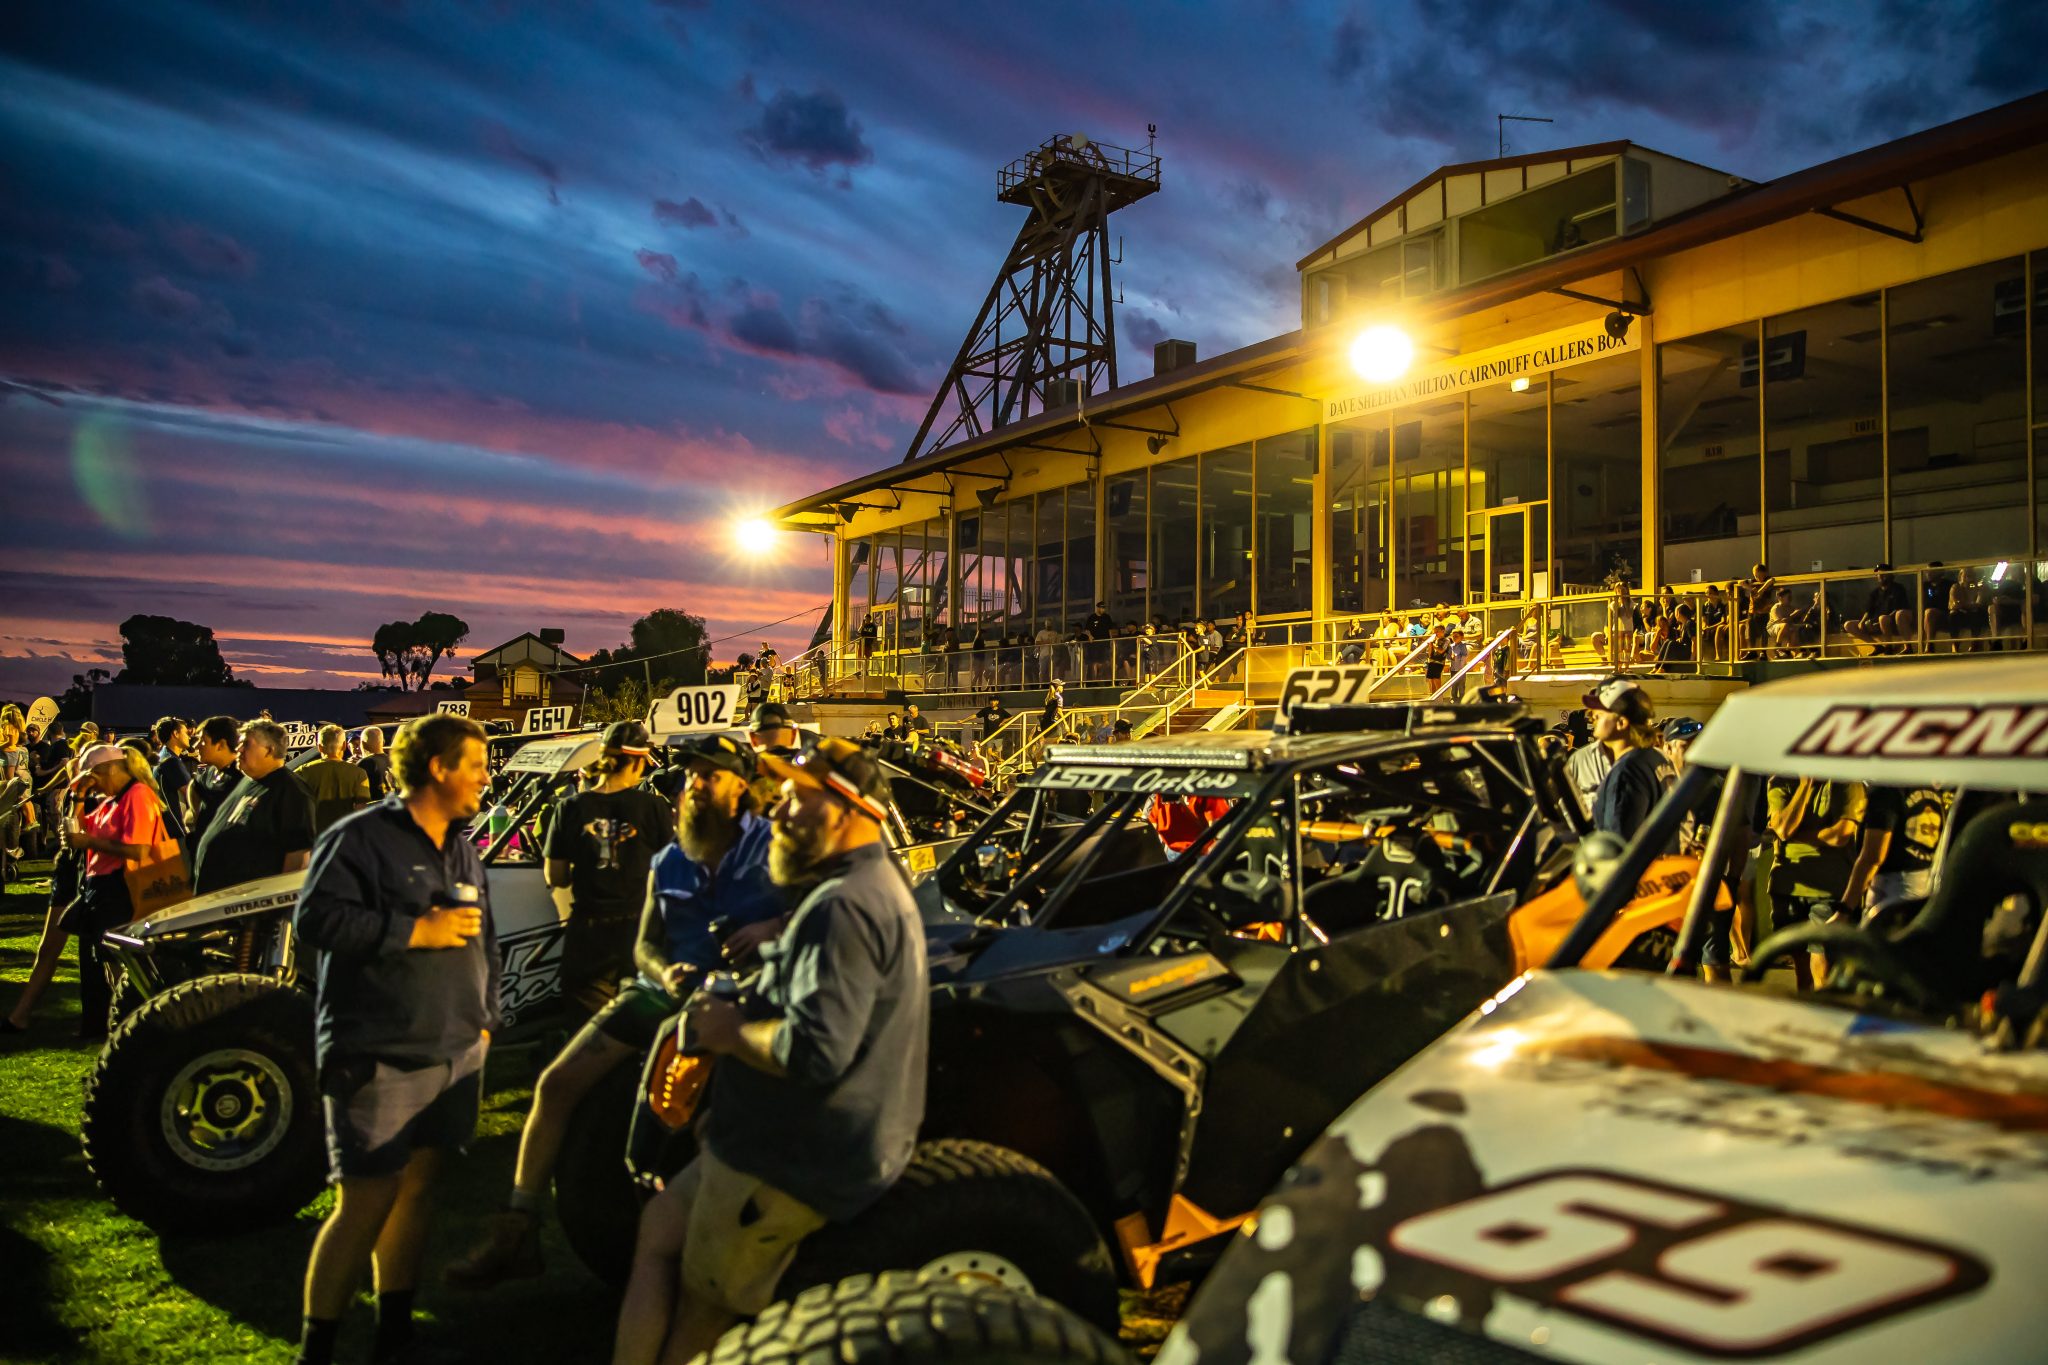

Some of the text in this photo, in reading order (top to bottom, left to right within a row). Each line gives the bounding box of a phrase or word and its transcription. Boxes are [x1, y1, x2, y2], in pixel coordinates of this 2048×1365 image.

[1330, 397, 1357, 417] DAVE
[1459, 353, 1531, 386] CAIRNDUFF
[1533, 338, 1594, 368] CALLERS
[1597, 333, 1628, 352] BOX
[439, 703, 468, 717] 788
[677, 690, 729, 726] 902
[1281, 669, 1371, 718] 627
[529, 707, 566, 733] 664
[223, 896, 274, 916] OUTBACK
[1388, 1166, 1968, 1355] 69
